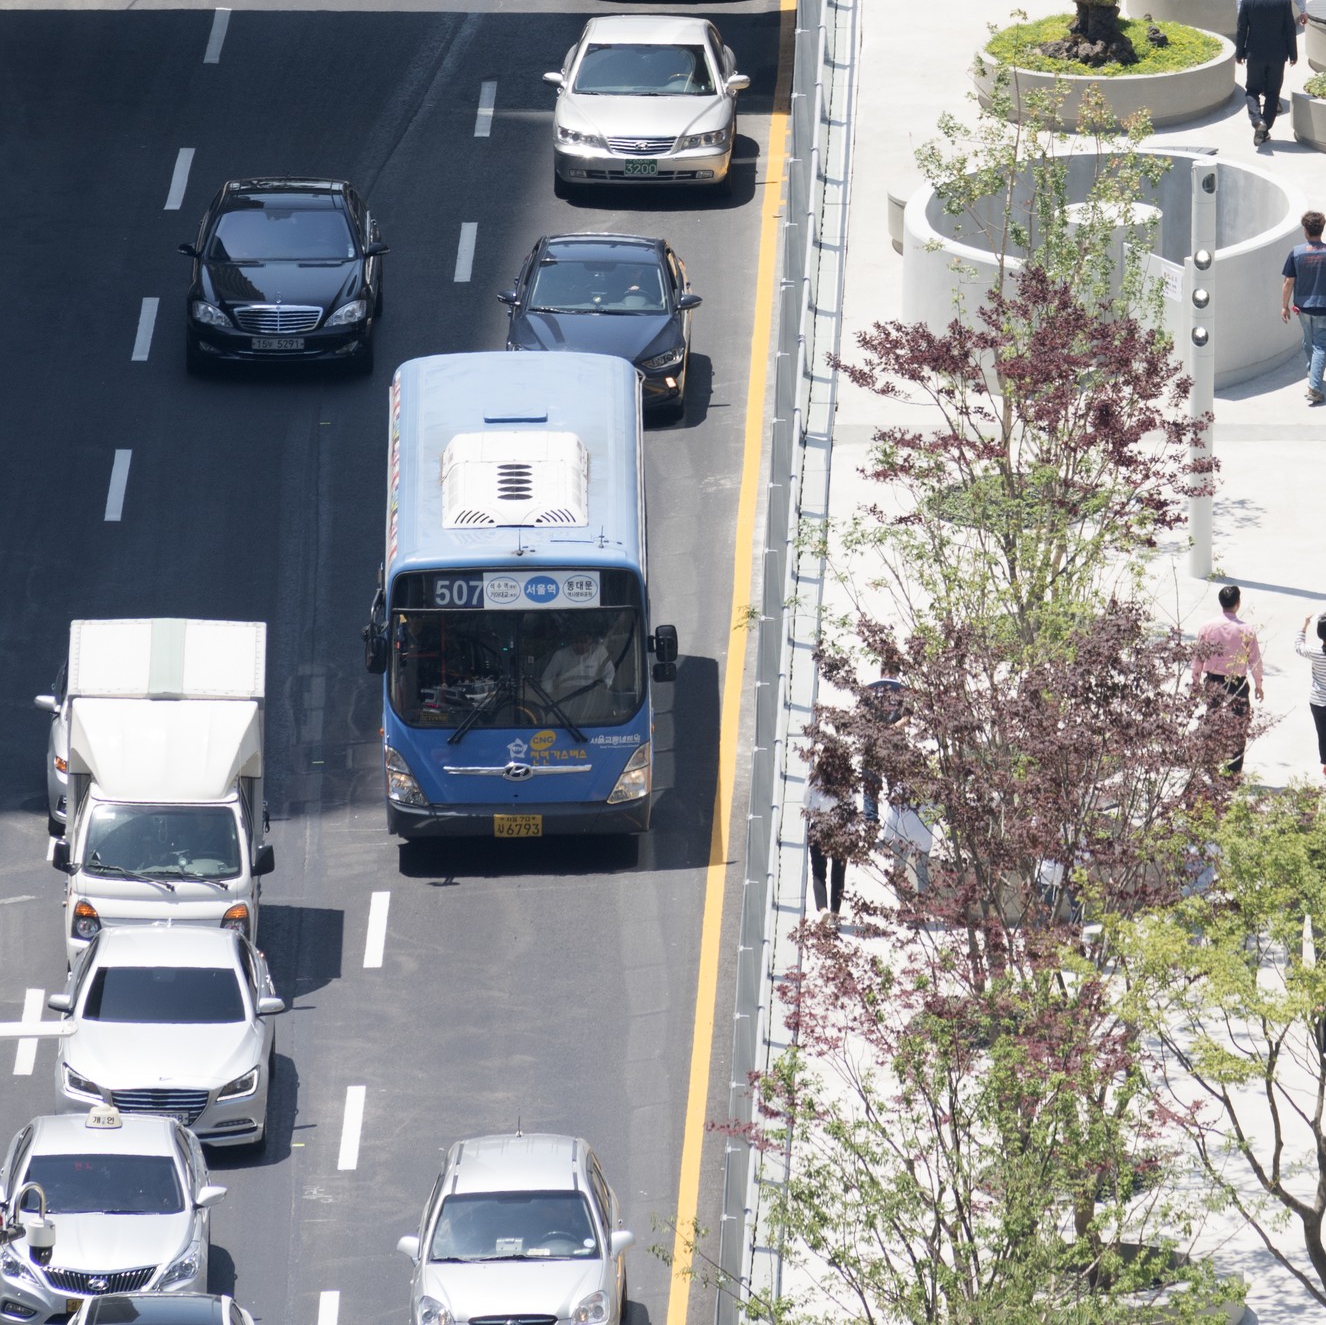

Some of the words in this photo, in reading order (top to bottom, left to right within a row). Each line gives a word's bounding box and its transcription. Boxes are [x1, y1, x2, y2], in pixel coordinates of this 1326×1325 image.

[625, 163, 657, 174] 3200
[278, 339, 299, 348] 5291
[526, 583, 557, 595] 서울역
[567, 580, 593, 591] 동대문
[435, 580, 484, 606] 507
[532, 736, 554, 744] CNG
[507, 823, 540, 835] 6793
[93, 1116, 115, 1125] 개인
